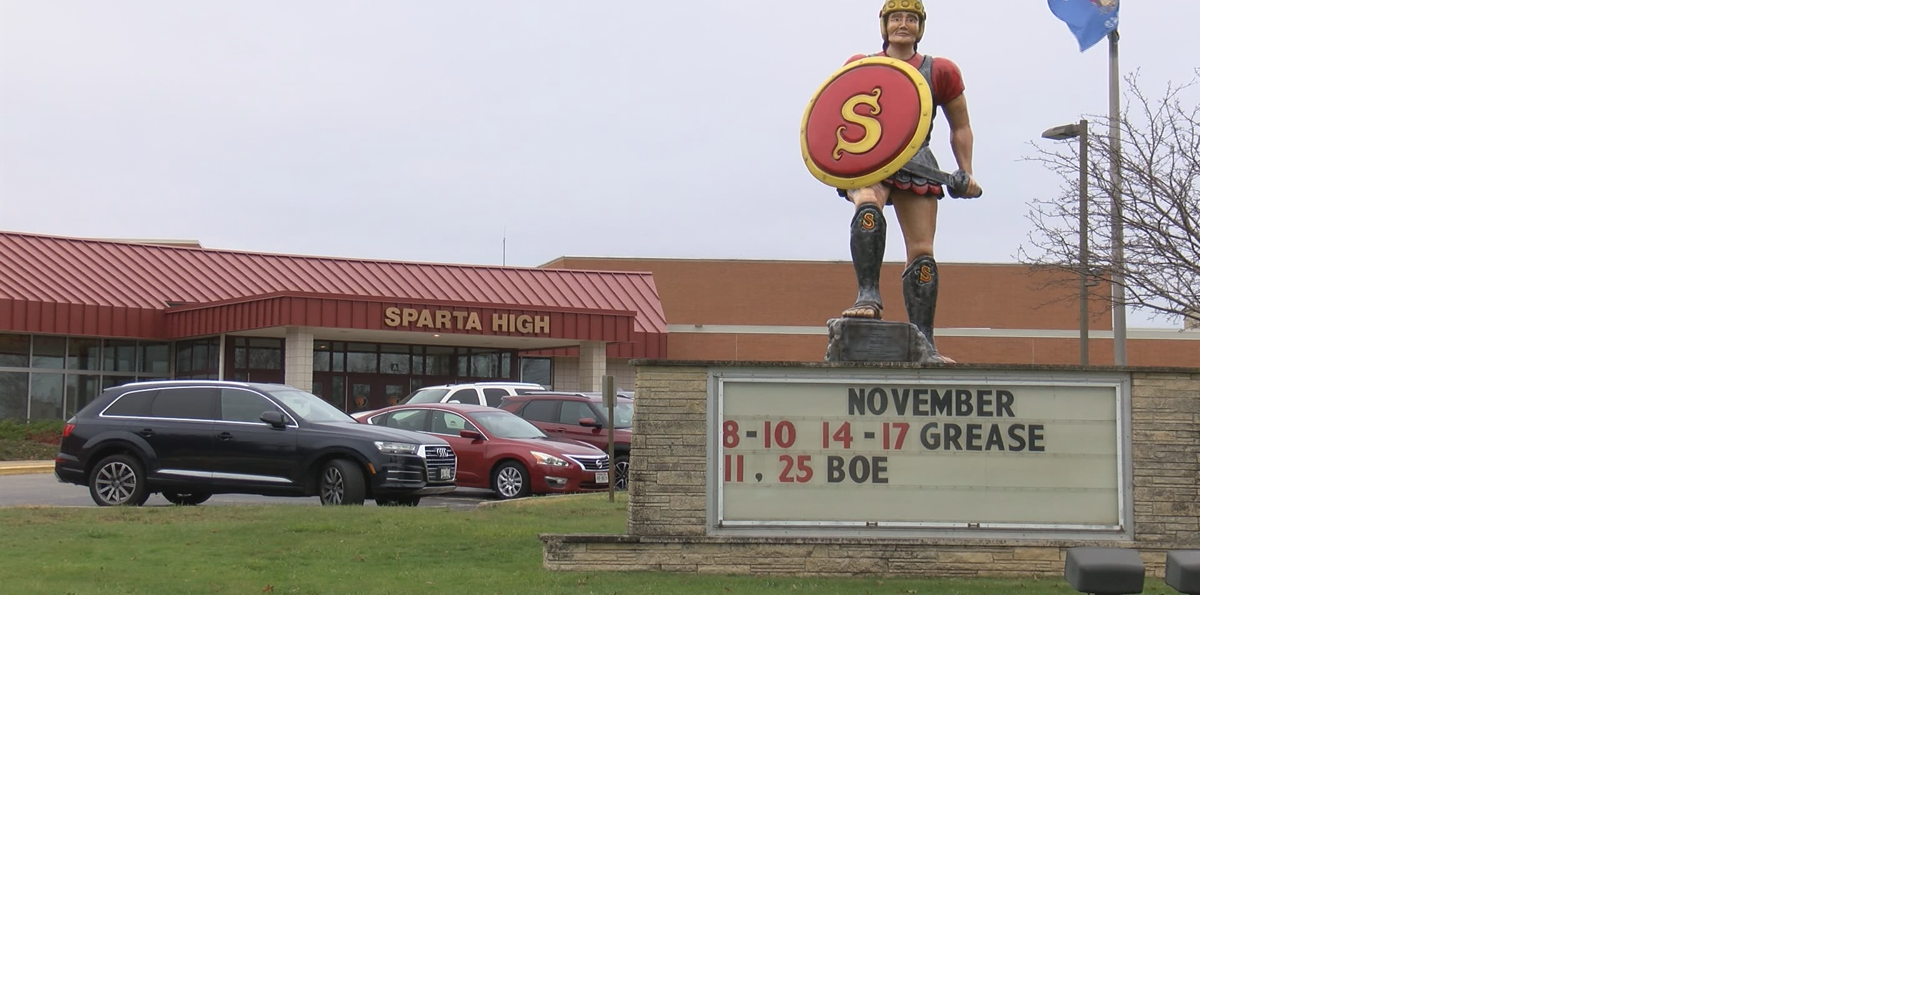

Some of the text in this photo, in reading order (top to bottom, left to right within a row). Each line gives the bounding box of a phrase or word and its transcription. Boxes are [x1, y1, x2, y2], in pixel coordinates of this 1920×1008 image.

[832, 86, 882, 160] S
[862, 212, 875, 230] S
[919, 265, 932, 283] S
[384, 306, 550, 334] SPARTA HIGH
[848, 387, 1015, 418] NOVEMBER
[920, 423, 1046, 453] GREASE
[778, 454, 814, 483] 25
[827, 455, 889, 484] BOE
